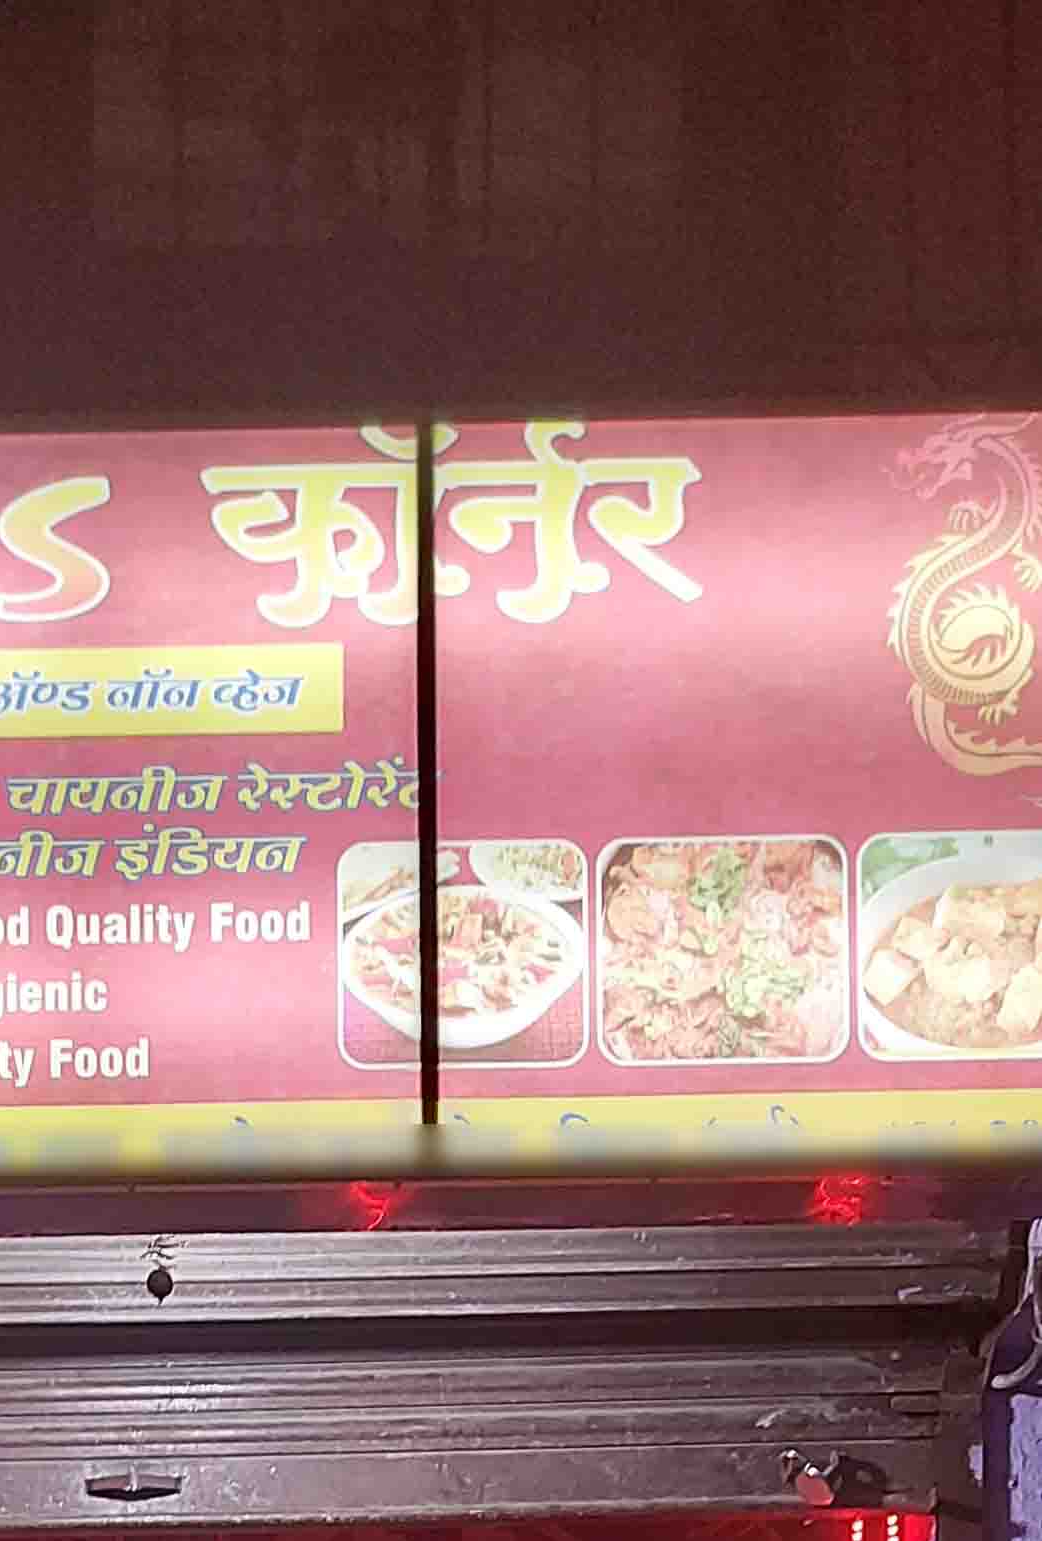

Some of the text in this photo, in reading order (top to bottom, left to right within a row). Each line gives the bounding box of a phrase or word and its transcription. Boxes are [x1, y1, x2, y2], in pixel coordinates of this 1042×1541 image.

[106, 666, 202, 711] नॉन
[212, 668, 304, 713] व्हेज
[4, 763, 228, 818] चायनीज
[113, 822, 308, 881] इंडियन
[45, 903, 195, 953] Quality
[209, 899, 311, 943] Food
[49, 1036, 150, 1080] Food
